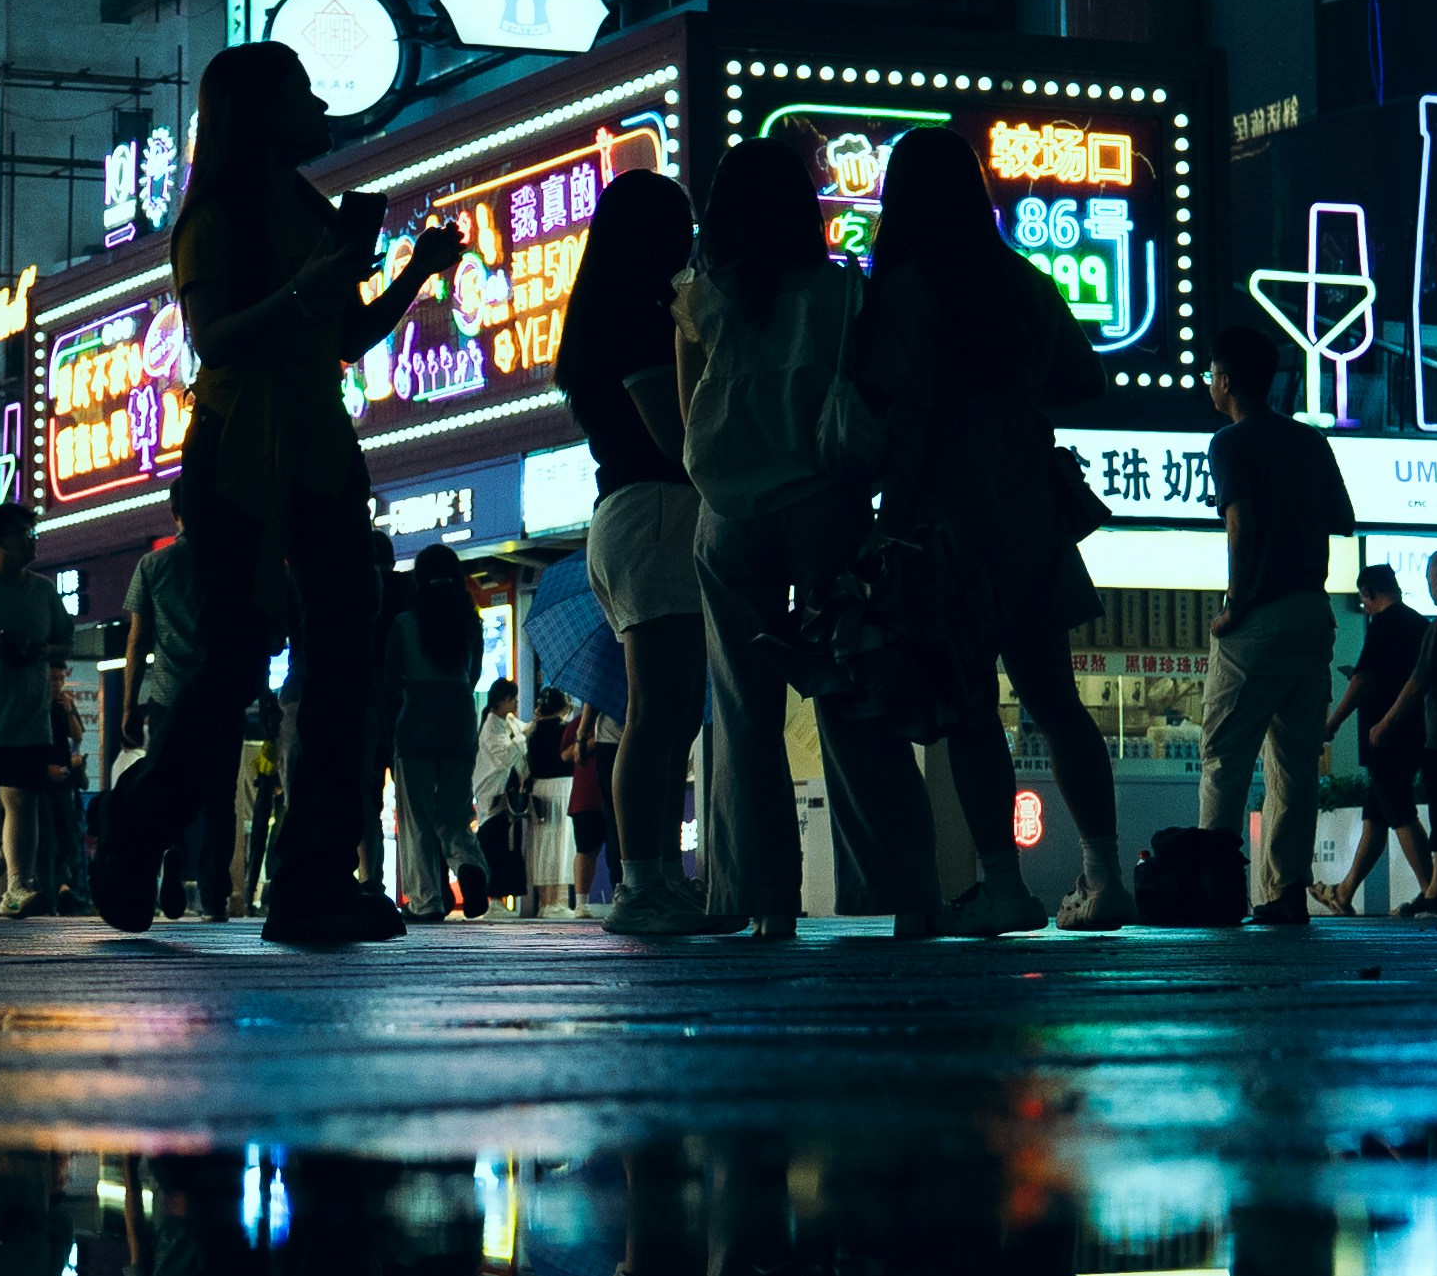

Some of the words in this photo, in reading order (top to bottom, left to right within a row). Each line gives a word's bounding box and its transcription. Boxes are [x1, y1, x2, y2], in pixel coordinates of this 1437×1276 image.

[989, 119, 1134, 186] 较场口
[510, 161, 597, 243] 我真的
[1070, 445, 1211, 503] 珠奶
